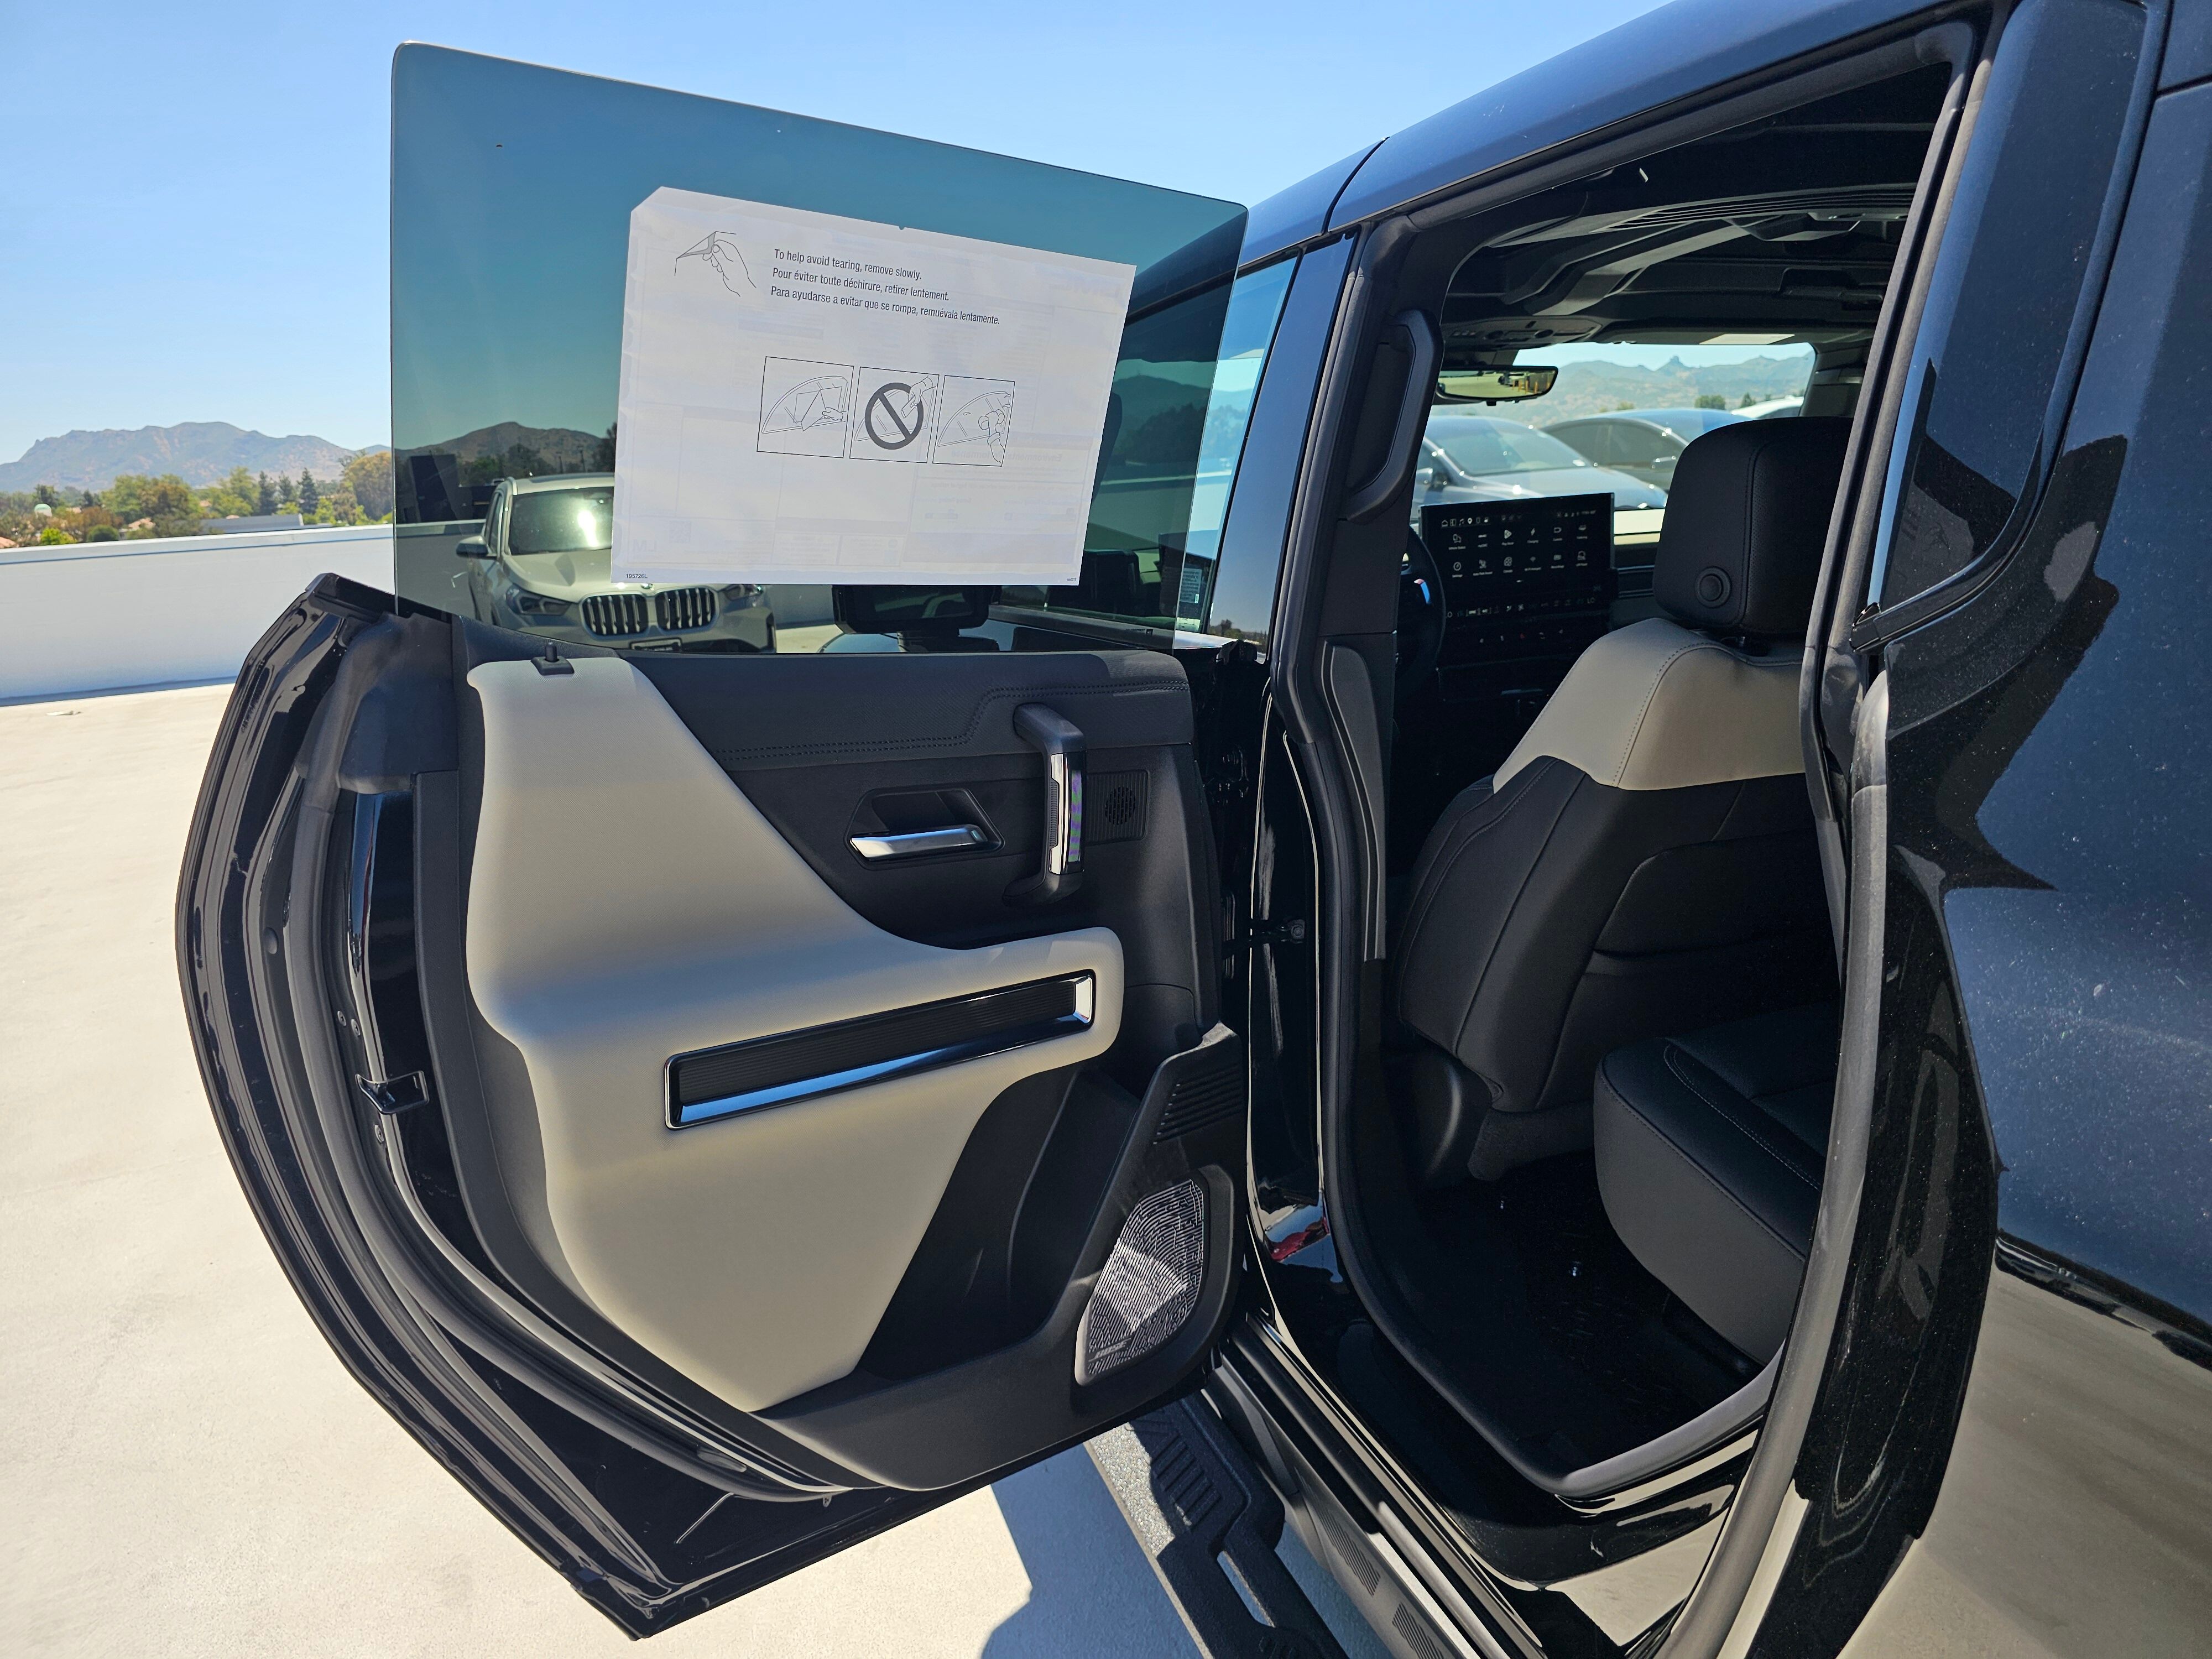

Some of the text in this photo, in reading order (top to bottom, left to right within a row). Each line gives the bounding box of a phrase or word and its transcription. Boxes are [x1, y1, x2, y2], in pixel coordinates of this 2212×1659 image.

[774, 248, 921, 281] To help avoid tearing, remove slowly.
[773, 267, 949, 301] Pour éviter toute déchirure, retirer lentement.
[771, 286, 790, 298] Para
[792, 291, 831, 303] ayudarse
[841, 296, 863, 307] evitar
[864, 300, 879, 310] que
[881, 302, 890, 311] se
[892, 304, 918, 316] rompa,
[921, 308, 958, 319] remuévala
[960, 311, 1000, 325] lentamente.
